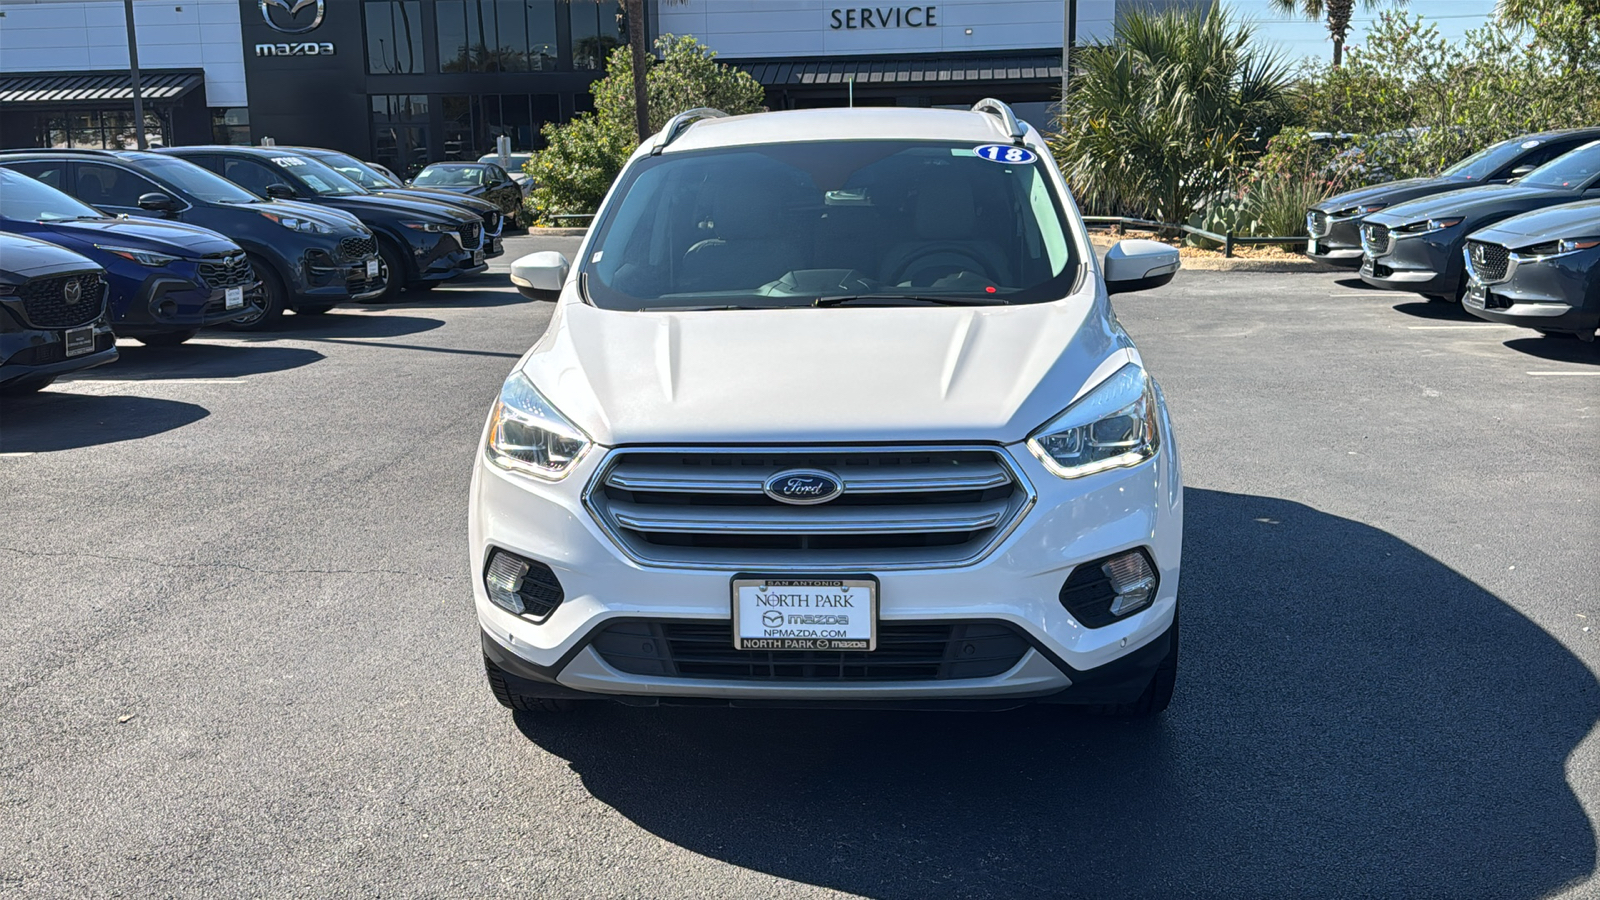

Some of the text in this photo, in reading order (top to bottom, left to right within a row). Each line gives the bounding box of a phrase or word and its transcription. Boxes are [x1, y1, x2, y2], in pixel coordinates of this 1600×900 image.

[830, 6, 937, 30] SERVICE
[255, 42, 334, 57] mazda
[987, 146, 1023, 162] 18
[783, 477, 823, 495] Ford
[755, 593, 854, 608] NORTH PARK
[787, 614, 850, 625] mazda
[763, 629, 847, 638] NPMAZDA.COM
[743, 639, 867, 649] NORTH PARK mazda
